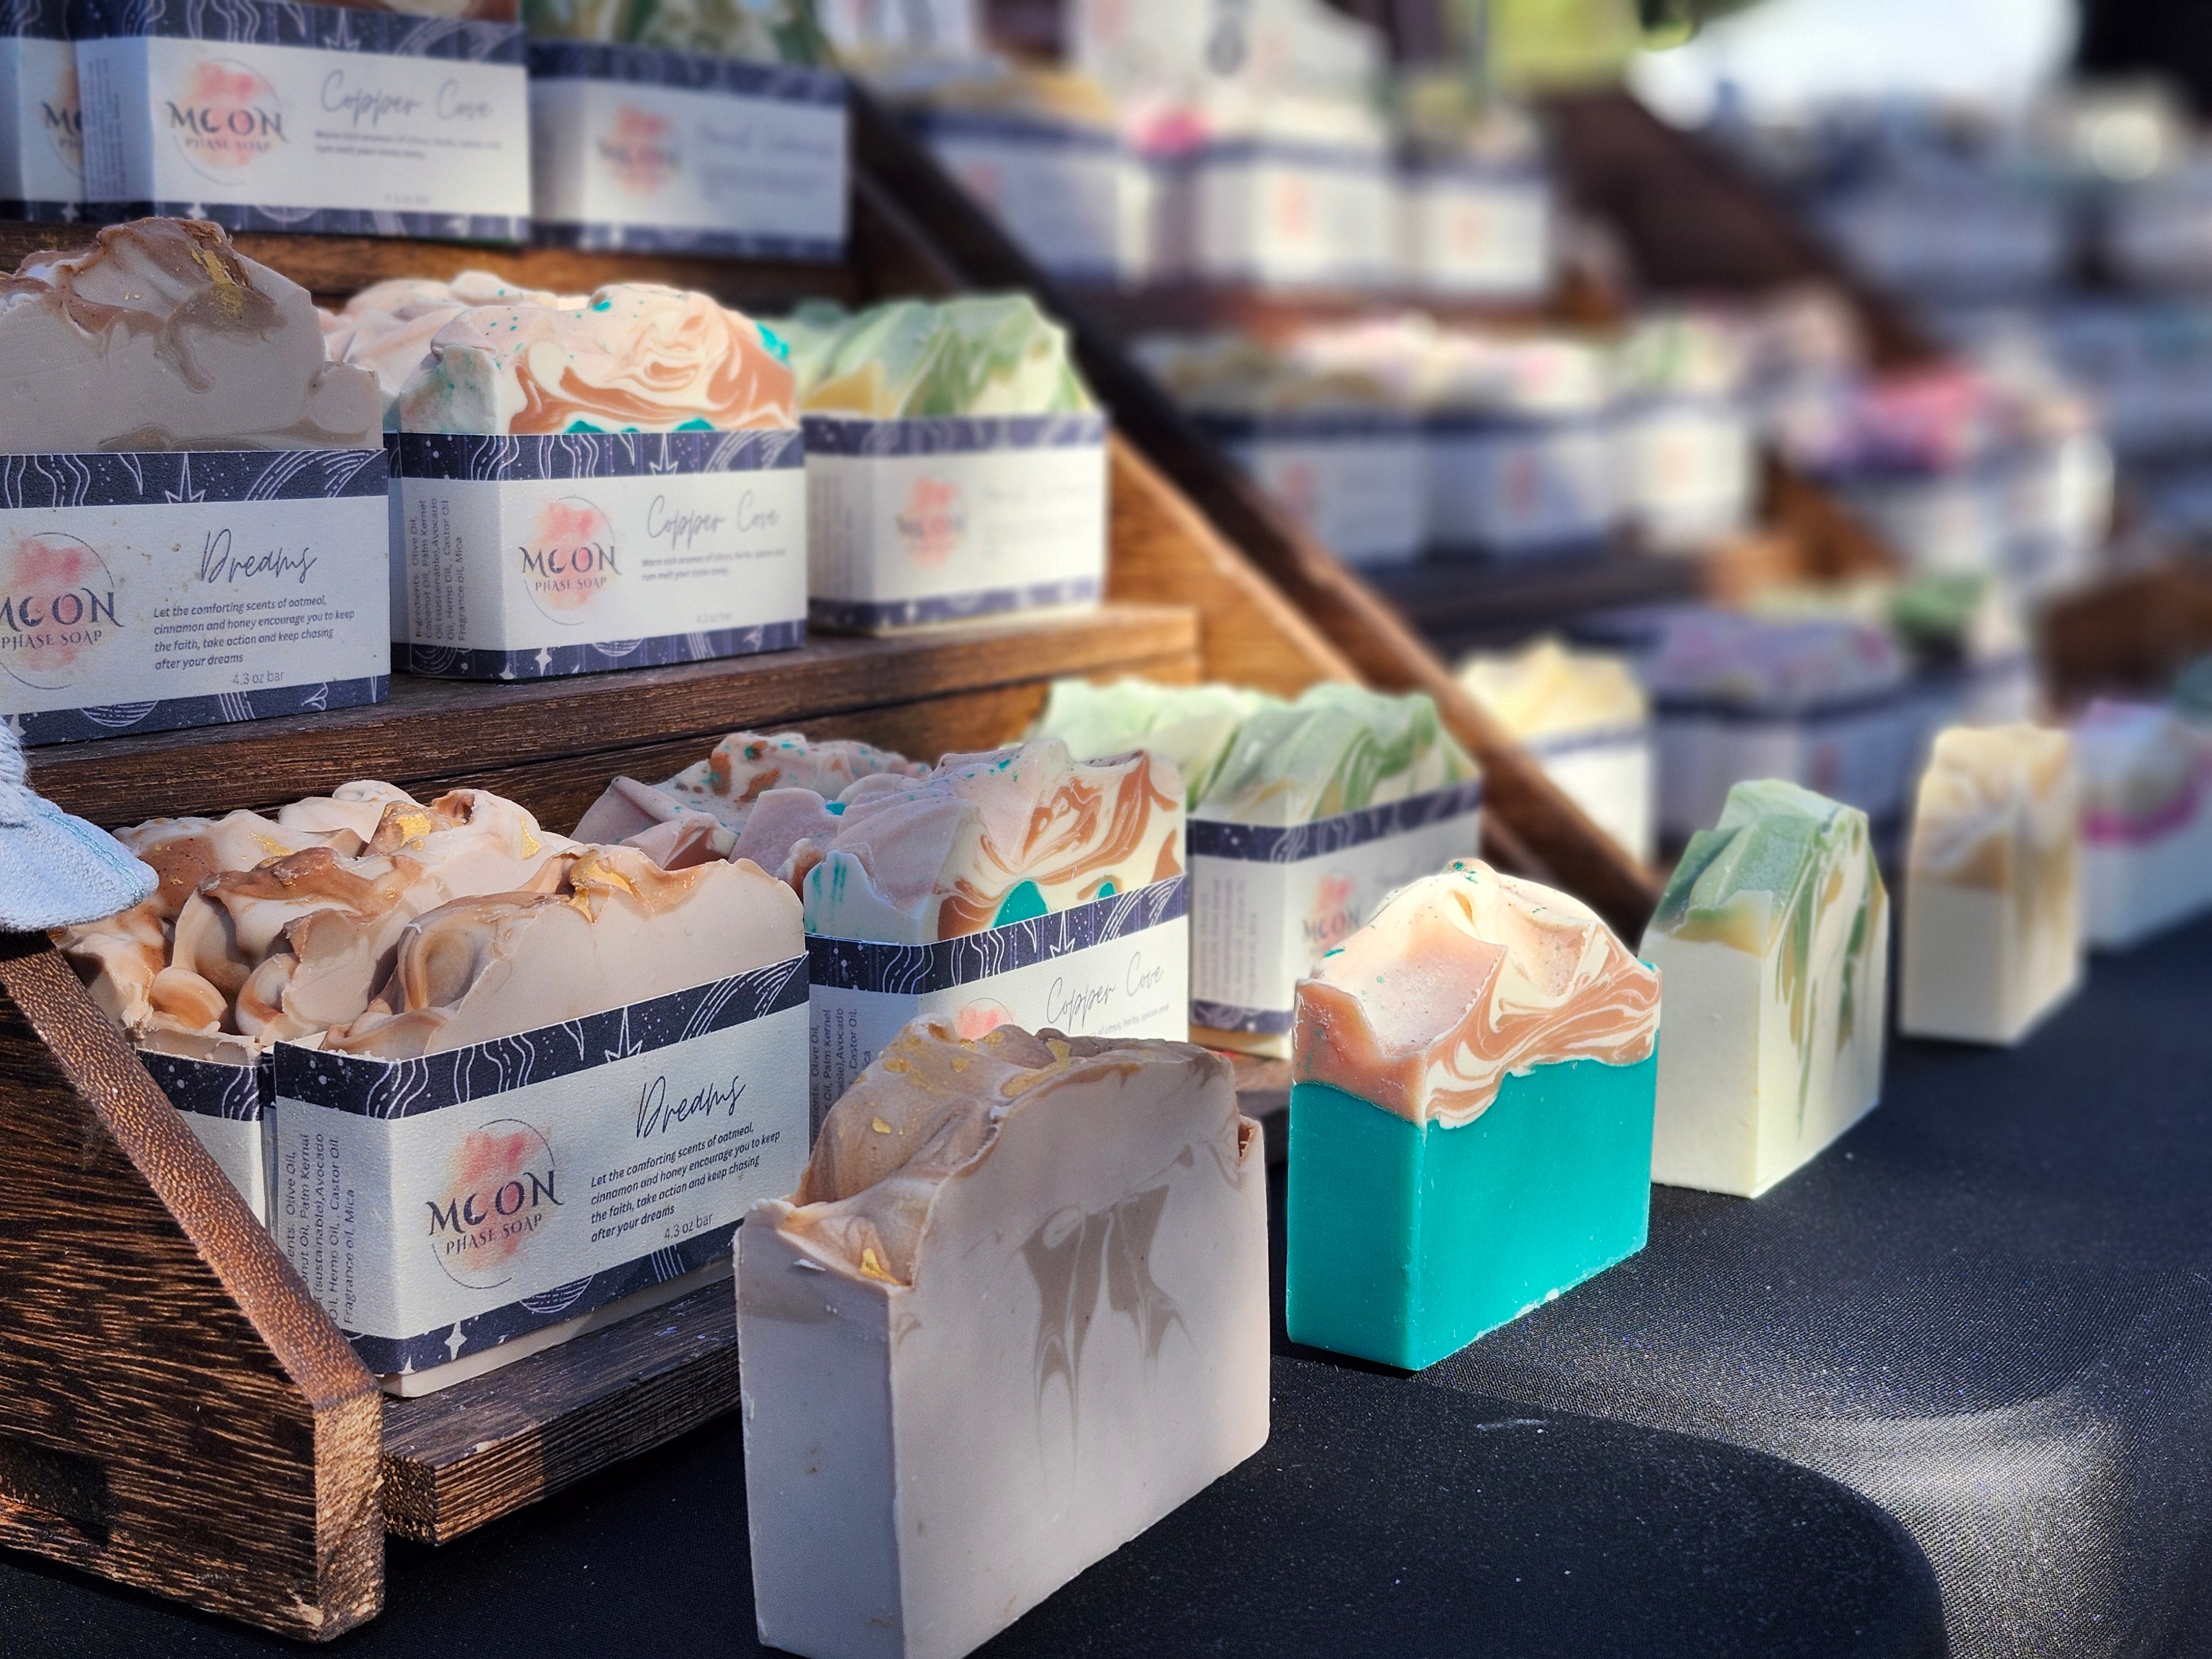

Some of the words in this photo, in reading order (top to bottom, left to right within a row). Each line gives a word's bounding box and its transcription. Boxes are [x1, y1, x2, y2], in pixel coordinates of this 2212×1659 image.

[321, 69, 421, 127] Copper
[648, 494, 726, 551] Copper
[737, 489, 780, 533] Cove
[201, 528, 317, 584] Dreams
[421, 539, 429, 567] Palm
[535, 580, 572, 593] PHASE
[577, 577, 607, 589] SOAP
[154, 608, 170, 618] Let
[173, 605, 189, 617] the
[191, 602, 244, 615] comforting
[246, 601, 276, 611] scents
[278, 597, 288, 608] of
[289, 595, 327, 608] oatmeal,
[154, 624, 205, 635] cinnamon
[206, 619, 226, 630] and
[227, 618, 257, 630] honey
[258, 616, 305, 626] encourage
[306, 614, 324, 625] you
[325, 612, 333, 620] to
[335, 610, 355, 620] keep
[423, 591, 432, 638] Coconut
[458, 586, 468, 641] Fragrance
[2, 634, 55, 650] PHASE
[60, 630, 102, 646] SOAP
[155, 641, 172, 652] the
[174, 639, 201, 651] faith,
[203, 637, 225, 649] take
[227, 635, 257, 646] action
[258, 633, 276, 643] and
[278, 631, 300, 643] keep
[301, 628, 335, 639] chasing
[155, 659, 181, 670] after
[182, 658, 206, 670] your
[207, 654, 244, 665] dreams
[233, 672, 250, 686] 4.3
[252, 673, 264, 684] oz
[267, 670, 284, 682] bar
[1047, 977, 1115, 1033] Copper
[1126, 951, 1165, 997] Cove
[811, 1025, 820, 1044] Oil,
[822, 1009, 831, 1046] Kernel
[823, 1050, 831, 1079] Palm
[849, 1030, 858, 1070] Castor
[636, 1076, 746, 1139] Dreams
[823, 1083, 833, 1101] Oil,
[285, 1152, 296, 1175] Oil,
[591, 1174, 607, 1188] Let
[609, 1168, 625, 1182] the
[626, 1151, 676, 1176] comforting
[678, 1141, 706, 1158] scents
[707, 1134, 718, 1147] of
[718, 1121, 754, 1144] oatmeal,
[591, 1182, 639, 1205] cinnamon
[640, 1172, 659, 1187] and
[660, 1165, 688, 1182] honey
[689, 1148, 733, 1171] encourage
[734, 1141, 750, 1158] you
[752, 1138, 760, 1149] to
[761, 1131, 781, 1145] keep
[285, 1178, 296, 1215] Olive
[300, 1184, 310, 1219] Palm
[330, 1161, 340, 1211] Castor
[591, 1210, 607, 1224] the
[609, 1200, 634, 1218] faith,
[637, 1193, 657, 1208] take
[659, 1182, 687, 1199] action
[688, 1173, 706, 1189] and
[707, 1167, 727, 1182] keep
[729, 1155, 760, 1175] chasing
[344, 1190, 354, 1223] Mica
[591, 1226, 616, 1243] after
[616, 1218, 640, 1238] your
[640, 1204, 675, 1225] dreams
[300, 1224, 310, 1247] Oil,
[330, 1223, 340, 1245] Oil,
[447, 1229, 495, 1255] PHASE
[503, 1213, 542, 1239] SOAP
[664, 1223, 680, 1240] 4.3
[682, 1220, 694, 1234] oz
[696, 1213, 713, 1229] bar
[328, 1250, 339, 1293] Hemp
[343, 1252, 356, 1324] Fragrance
